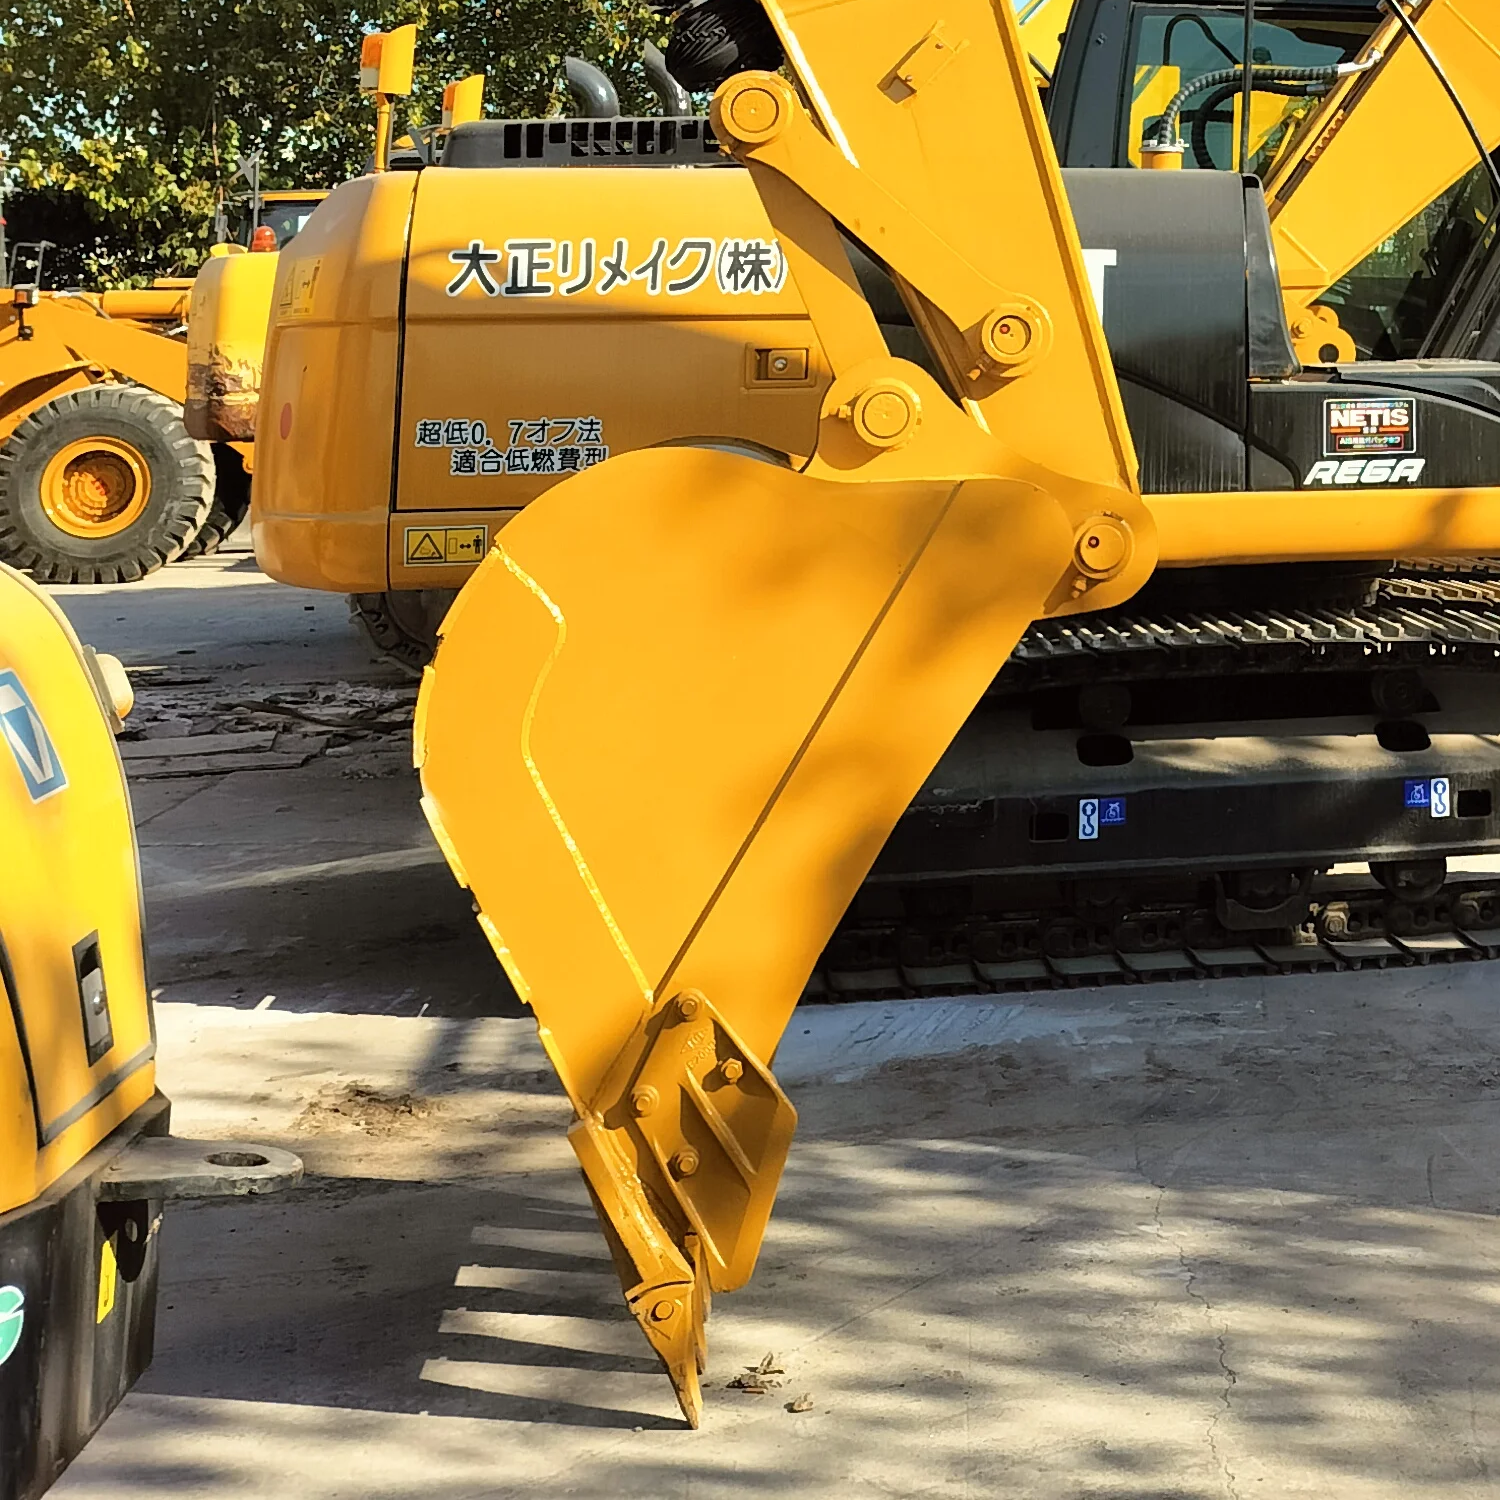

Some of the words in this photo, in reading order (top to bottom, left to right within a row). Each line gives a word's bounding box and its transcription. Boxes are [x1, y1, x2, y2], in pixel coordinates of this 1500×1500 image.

[446, 240, 785, 295] 大正リメイク(株)
[1330, 408, 1409, 428] NETIS
[452, 446, 607, 473] 適合低燃費型
[1303, 458, 1426, 485] REGA
